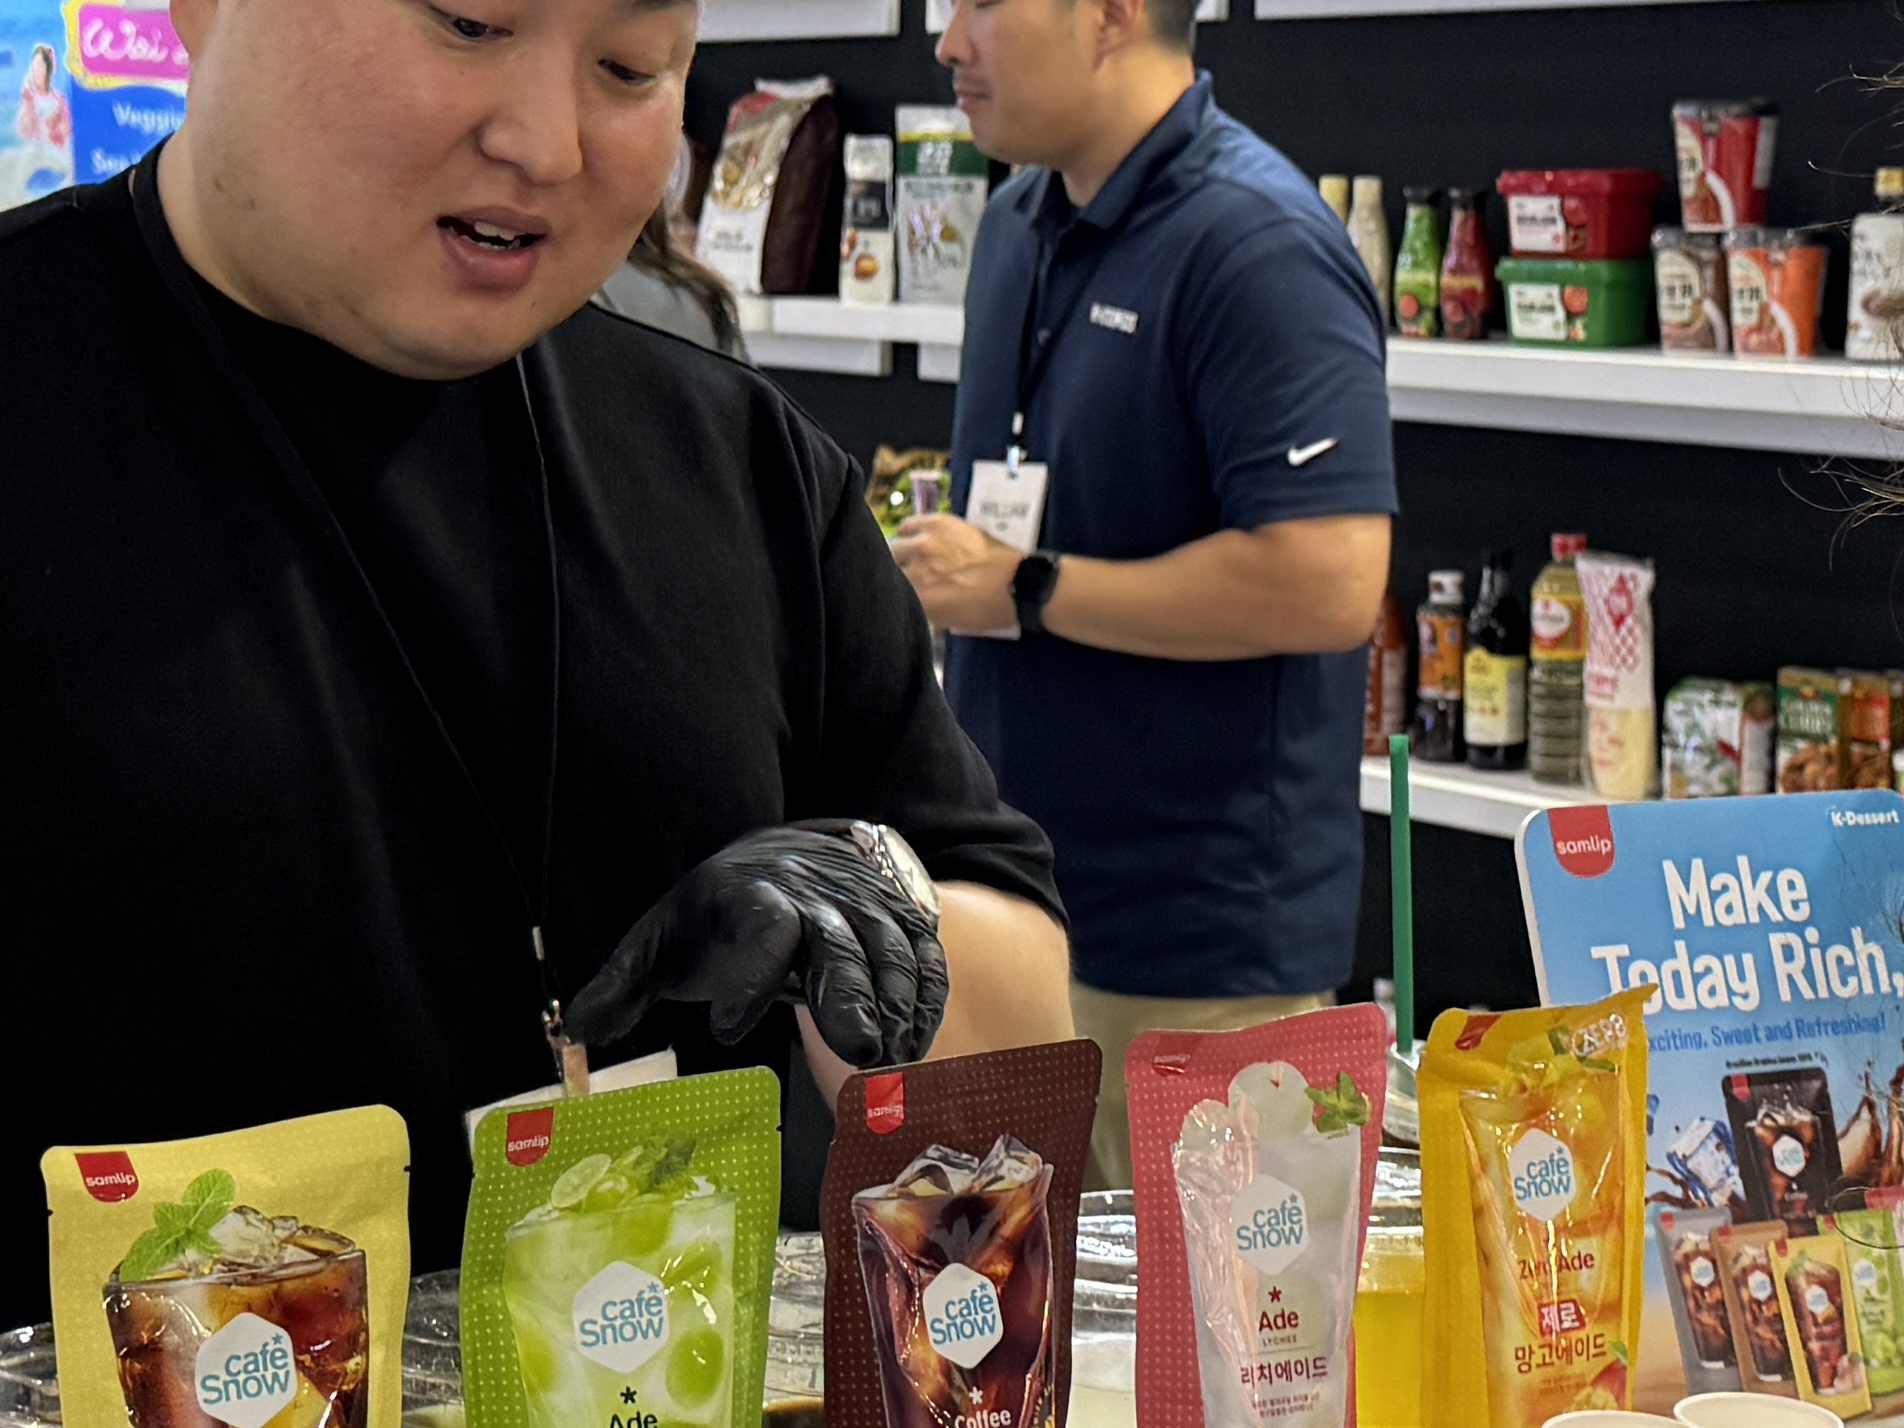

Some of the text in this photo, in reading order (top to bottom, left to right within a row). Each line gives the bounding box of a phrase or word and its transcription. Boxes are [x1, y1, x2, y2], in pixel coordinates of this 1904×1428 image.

[1830, 808, 1900, 827] K-Dessert
[1555, 835, 1612, 856] samlip
[1662, 854, 1811, 930] Make
[1591, 939, 1761, 1015] Today
[1647, 1028, 1708, 1053] xciting,
[1711, 1022, 1761, 1047] Sweet
[1764, 1020, 1794, 1043] and
[507, 1134, 550, 1152] samlip
[85, 1171, 137, 1188] samlip
[1514, 1176, 1571, 1201] Snow
[1236, 1223, 1304, 1251] Snow
[1558, 1250, 1595, 1274] Ade
[579, 1316, 665, 1348] Snow
[929, 1313, 997, 1346] Snow
[1258, 1308, 1300, 1332] Ade
[1240, 1356, 1328, 1388] 리치에이드
[200, 1369, 291, 1406] Snow
